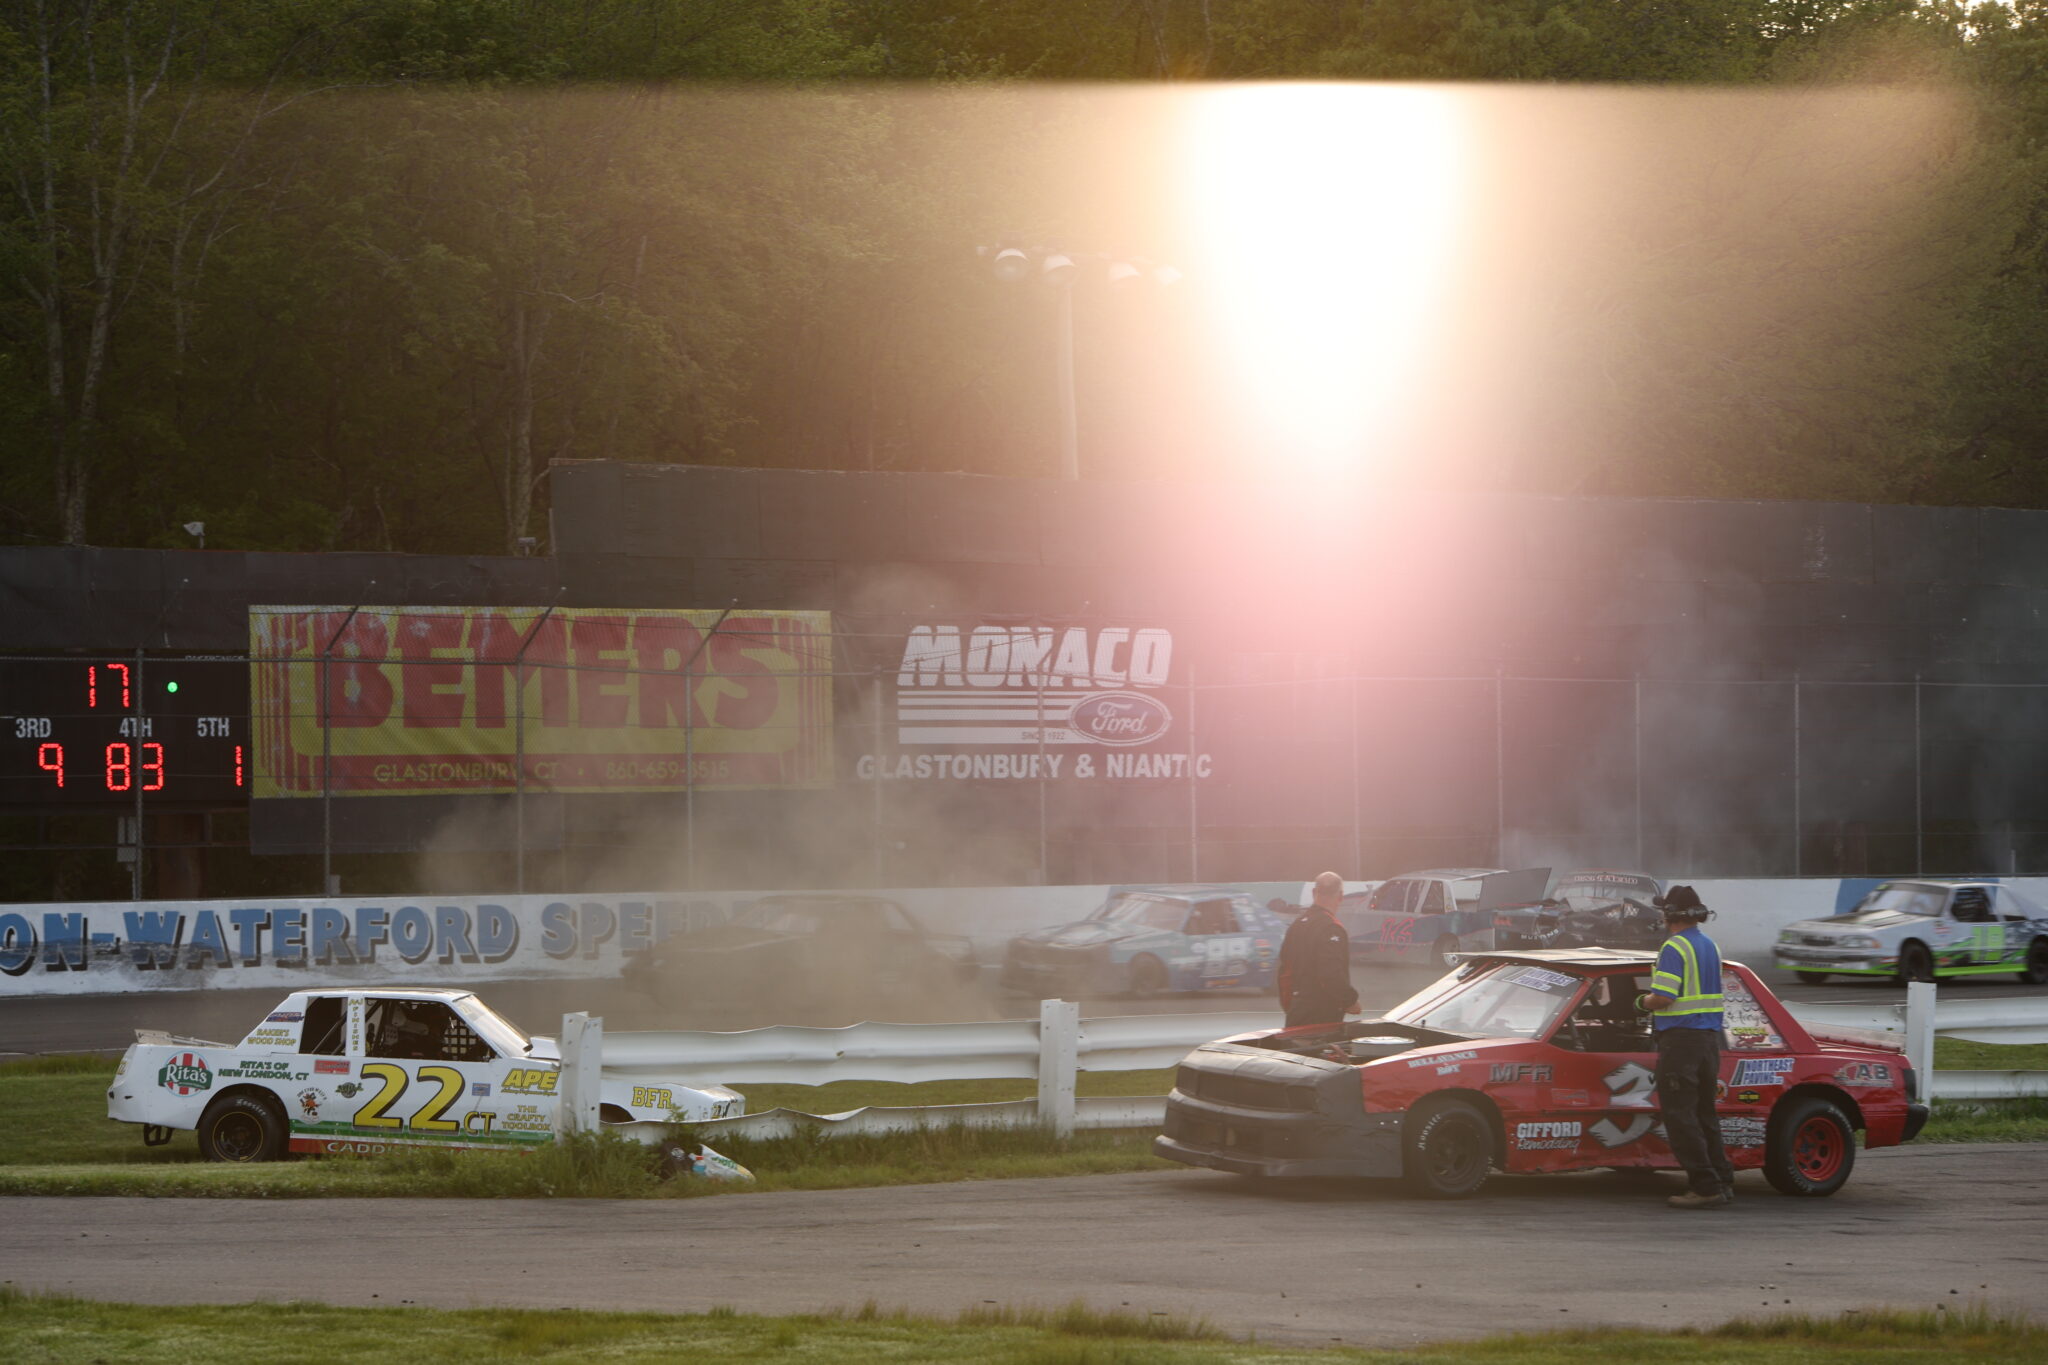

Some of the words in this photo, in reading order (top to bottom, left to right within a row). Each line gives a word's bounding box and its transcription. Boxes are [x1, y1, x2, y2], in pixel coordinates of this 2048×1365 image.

[897, 625, 1173, 689] MONACO
[311, 612, 781, 731] BEMERS
[89, 663, 129, 707] 17
[1091, 701, 1148, 733] Ford
[16, 718, 52, 738] 3RD
[119, 718, 152, 737] 4TH
[197, 718, 230, 737] 5TH
[1021, 731, 1045, 740] SINC
[38, 743, 64, 788] 9
[106, 743, 163, 791] 83
[235, 745, 243, 787] 1
[534, 761, 560, 780] CT
[856, 754, 1064, 780] GLASTONBURY
[1075, 753, 1096, 779] &
[247, 1037, 275, 1045] WOOD
[274, 1038, 297, 1047] SHOP
[165, 1064, 208, 1084] Rita's
[218, 1069, 244, 1078] NEW
[295, 1072, 309, 1081] CT
[240, 1060, 272, 1070] RITA'S
[273, 1061, 289, 1071] OF
[1746, 1059, 1795, 1073] NORTHEAST
[501, 1068, 560, 1091] APE
[1743, 1072, 1775, 1085] PAVING
[352, 1063, 467, 1132] 22
[631, 1086, 673, 1110] BFR
[506, 1113, 546, 1123] CRAFTY
[517, 1104, 537, 1114] THE
[463, 1110, 496, 1136] CT
[501, 1121, 551, 1131] TOOLBOX
[1516, 1121, 1583, 1139] GIFFORD
